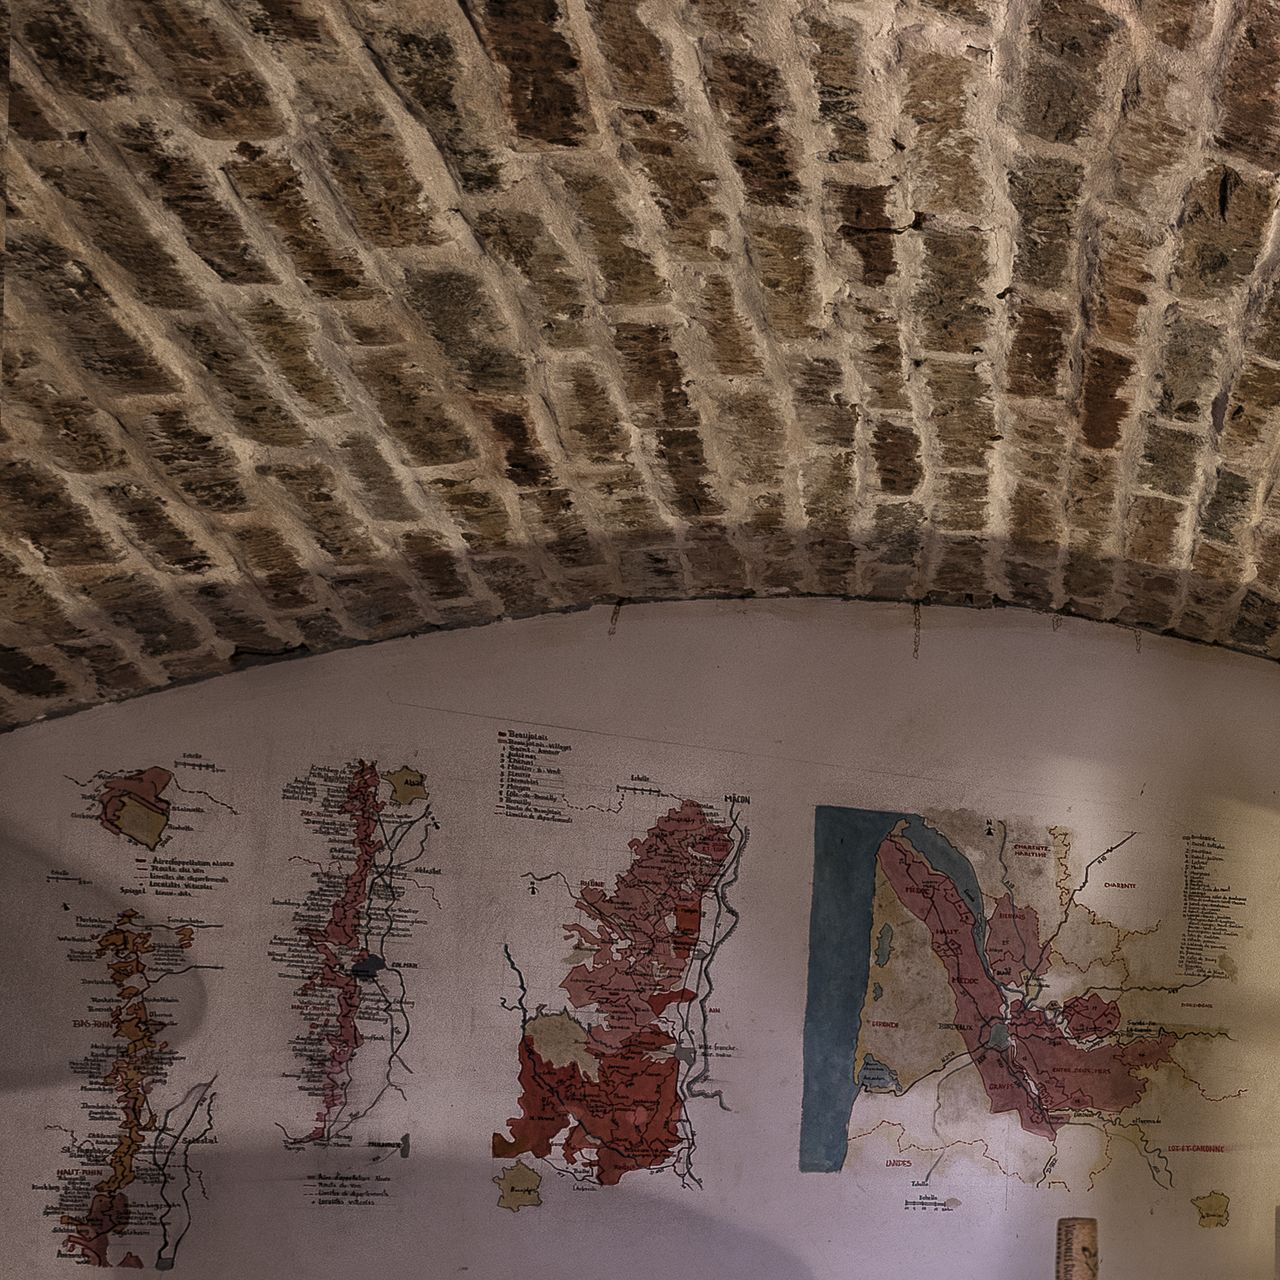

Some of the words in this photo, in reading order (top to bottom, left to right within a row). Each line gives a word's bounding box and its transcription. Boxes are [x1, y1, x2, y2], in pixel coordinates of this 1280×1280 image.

[507, 729, 548, 741] Beaujolais
[1104, 881, 1137, 889] CHARENTE
[885, 1160, 912, 1168] LANDES
